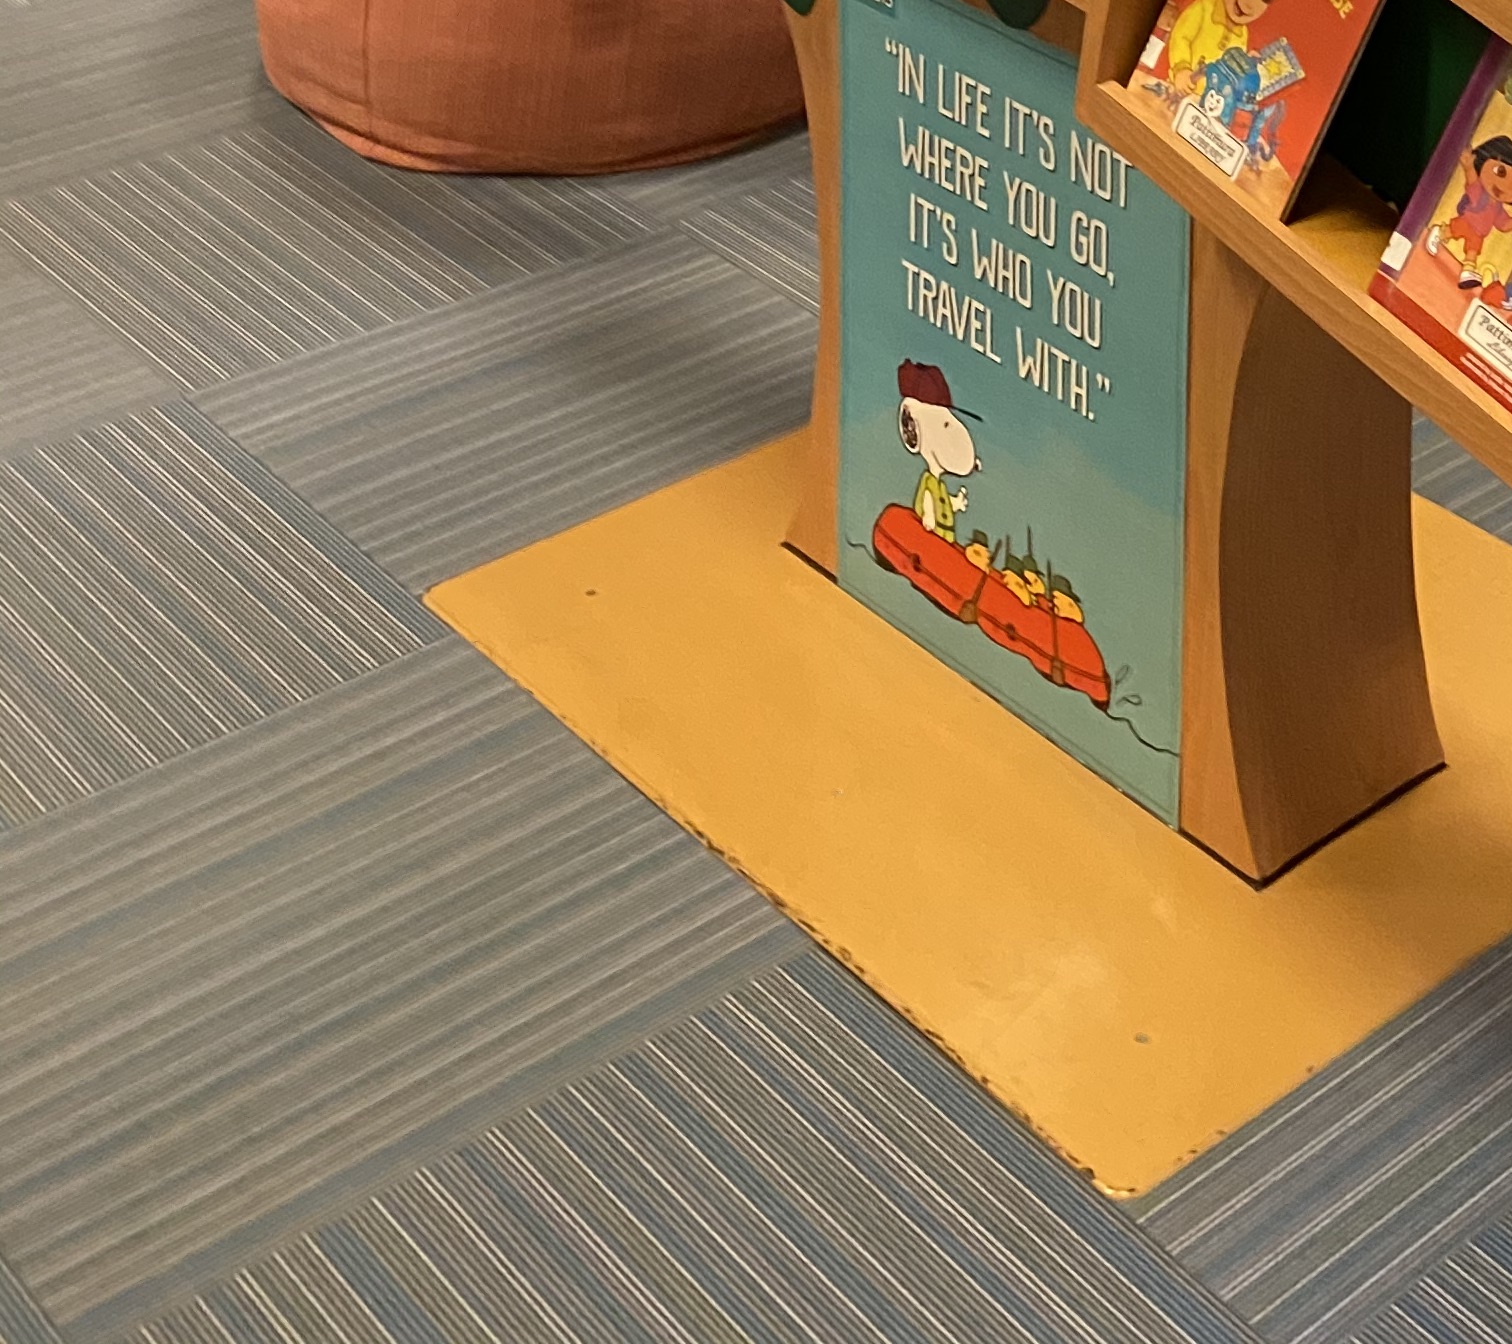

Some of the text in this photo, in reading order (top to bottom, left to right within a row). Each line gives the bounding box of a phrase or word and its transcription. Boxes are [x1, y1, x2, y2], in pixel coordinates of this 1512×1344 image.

[898, 117, 1115, 287] WHERE YOU GO,
[938, 64, 992, 138] LIFE
[1004, 96, 1056, 171] IT'S
[1070, 130, 1134, 208] NOT
[901, 259, 1002, 364] TRAVEL
[909, 192, 1102, 348] IT'S WHO YOU
